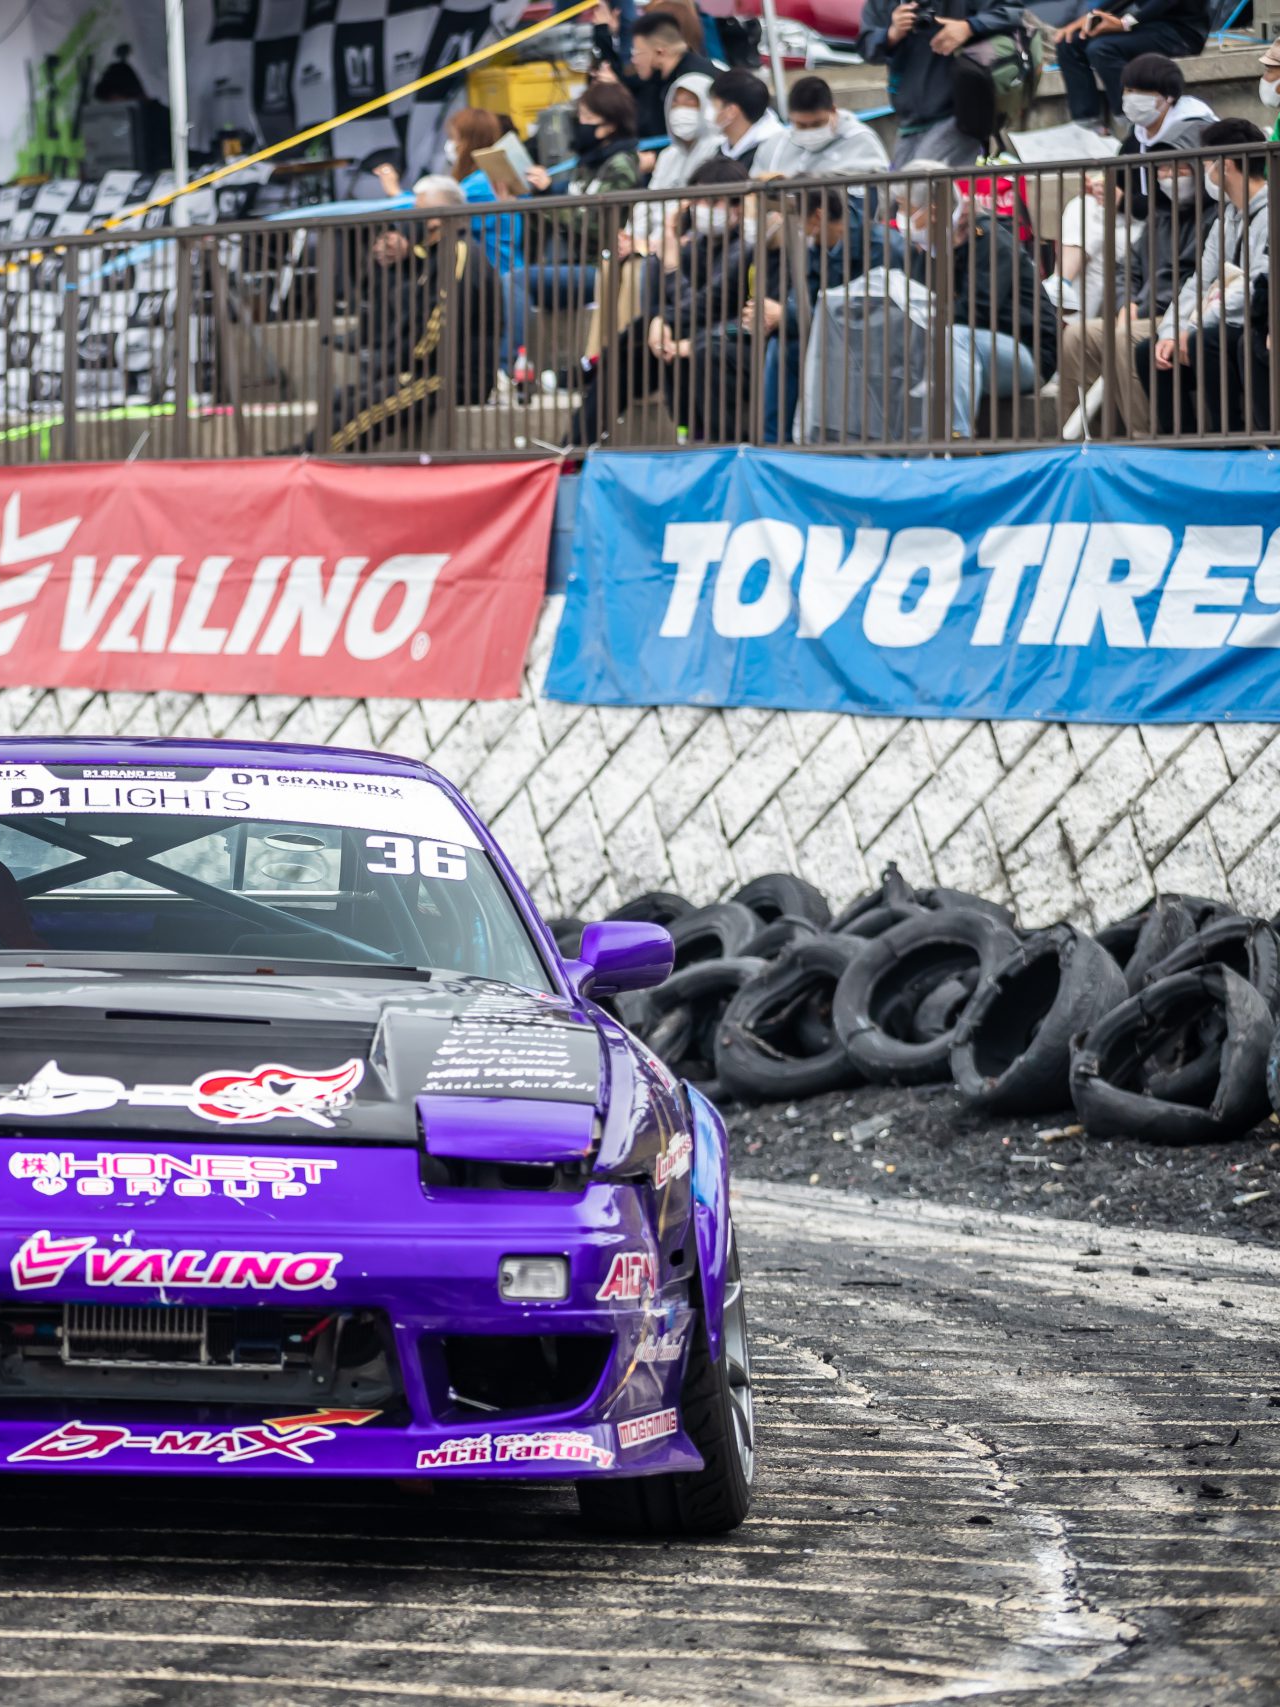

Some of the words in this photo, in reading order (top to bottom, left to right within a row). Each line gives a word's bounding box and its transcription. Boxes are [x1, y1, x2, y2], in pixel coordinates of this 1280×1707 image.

[659, 517, 967, 649] TOYO
[60, 552, 451, 661] VALINO
[231, 772, 270, 786] D1
[276, 775, 348, 790] GRAND
[353, 781, 403, 796] PRIX
[366, 836, 467, 882] 36
[62, 1153, 336, 1184] HONEST
[78, 1179, 307, 1199] GROUP
[88, 1251, 340, 1288] VALINO
[8, 1420, 336, 1464] D-MAX
[419, 1447, 487, 1466] MCR
[498, 1443, 613, 1466] Factory
